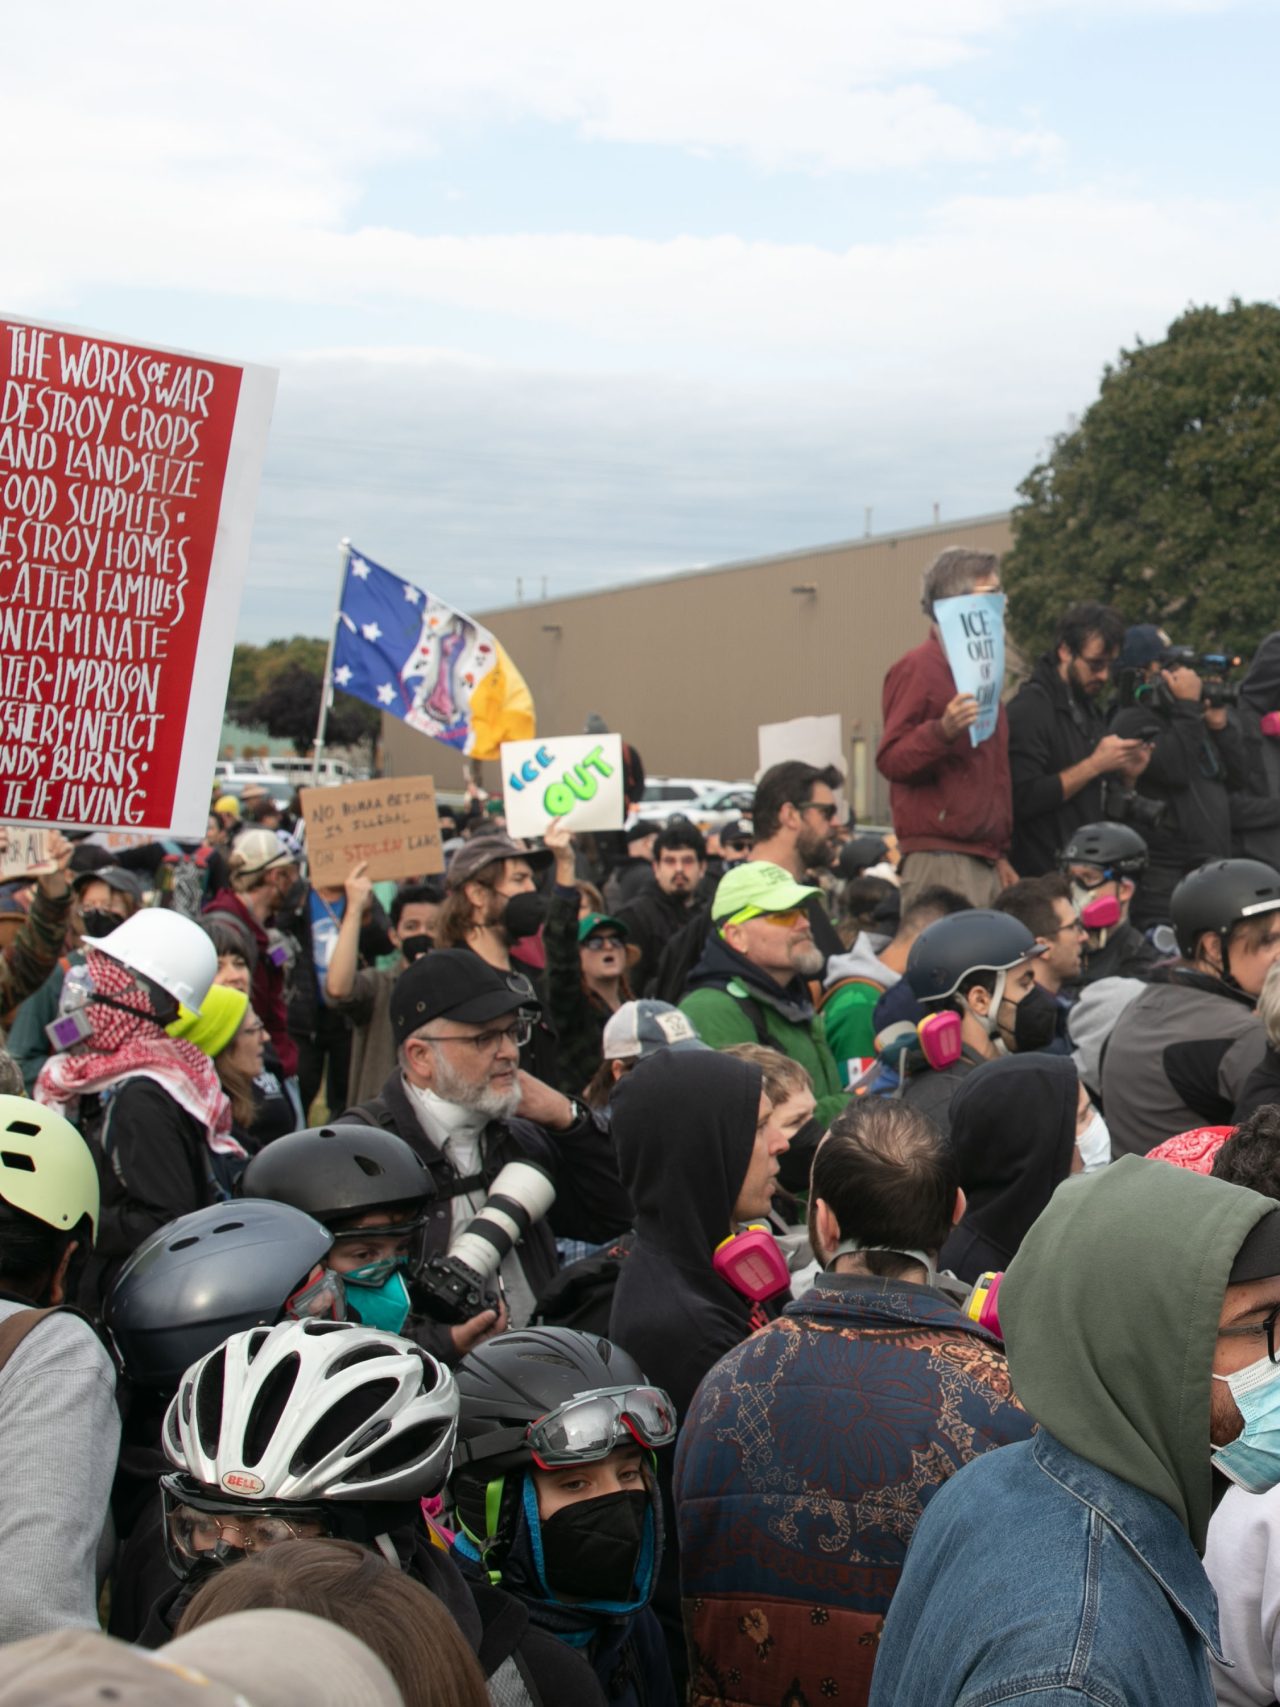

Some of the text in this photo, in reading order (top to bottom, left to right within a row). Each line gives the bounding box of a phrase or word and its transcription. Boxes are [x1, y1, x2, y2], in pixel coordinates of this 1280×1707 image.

[7, 325, 214, 417] THE WORKS OF WAR
[0, 380, 203, 458] DESTROY CROPS
[0, 426, 56, 470] AND
[137, 452, 204, 498] SEIZE
[0, 516, 191, 581] ESTROY HOMES
[95, 569, 188, 626] FAMILIES
[0, 607, 170, 660] NTAMINATE
[960, 610, 992, 638] ICE
[967, 640, 994, 661] OUT
[53, 656, 161, 714] IMPRISON
[70, 707, 165, 754] INFLICT
[510, 746, 555, 791] ICE
[543, 745, 614, 817] OUT
[3, 776, 146, 825] THE LIVING
[312, 804, 335, 822] NO
[352, 813, 411, 830] ILLEGAL
[314, 849, 334, 866] ON
[343, 836, 403, 862] STOLEN
[228, 1475, 256, 1489] BELL
